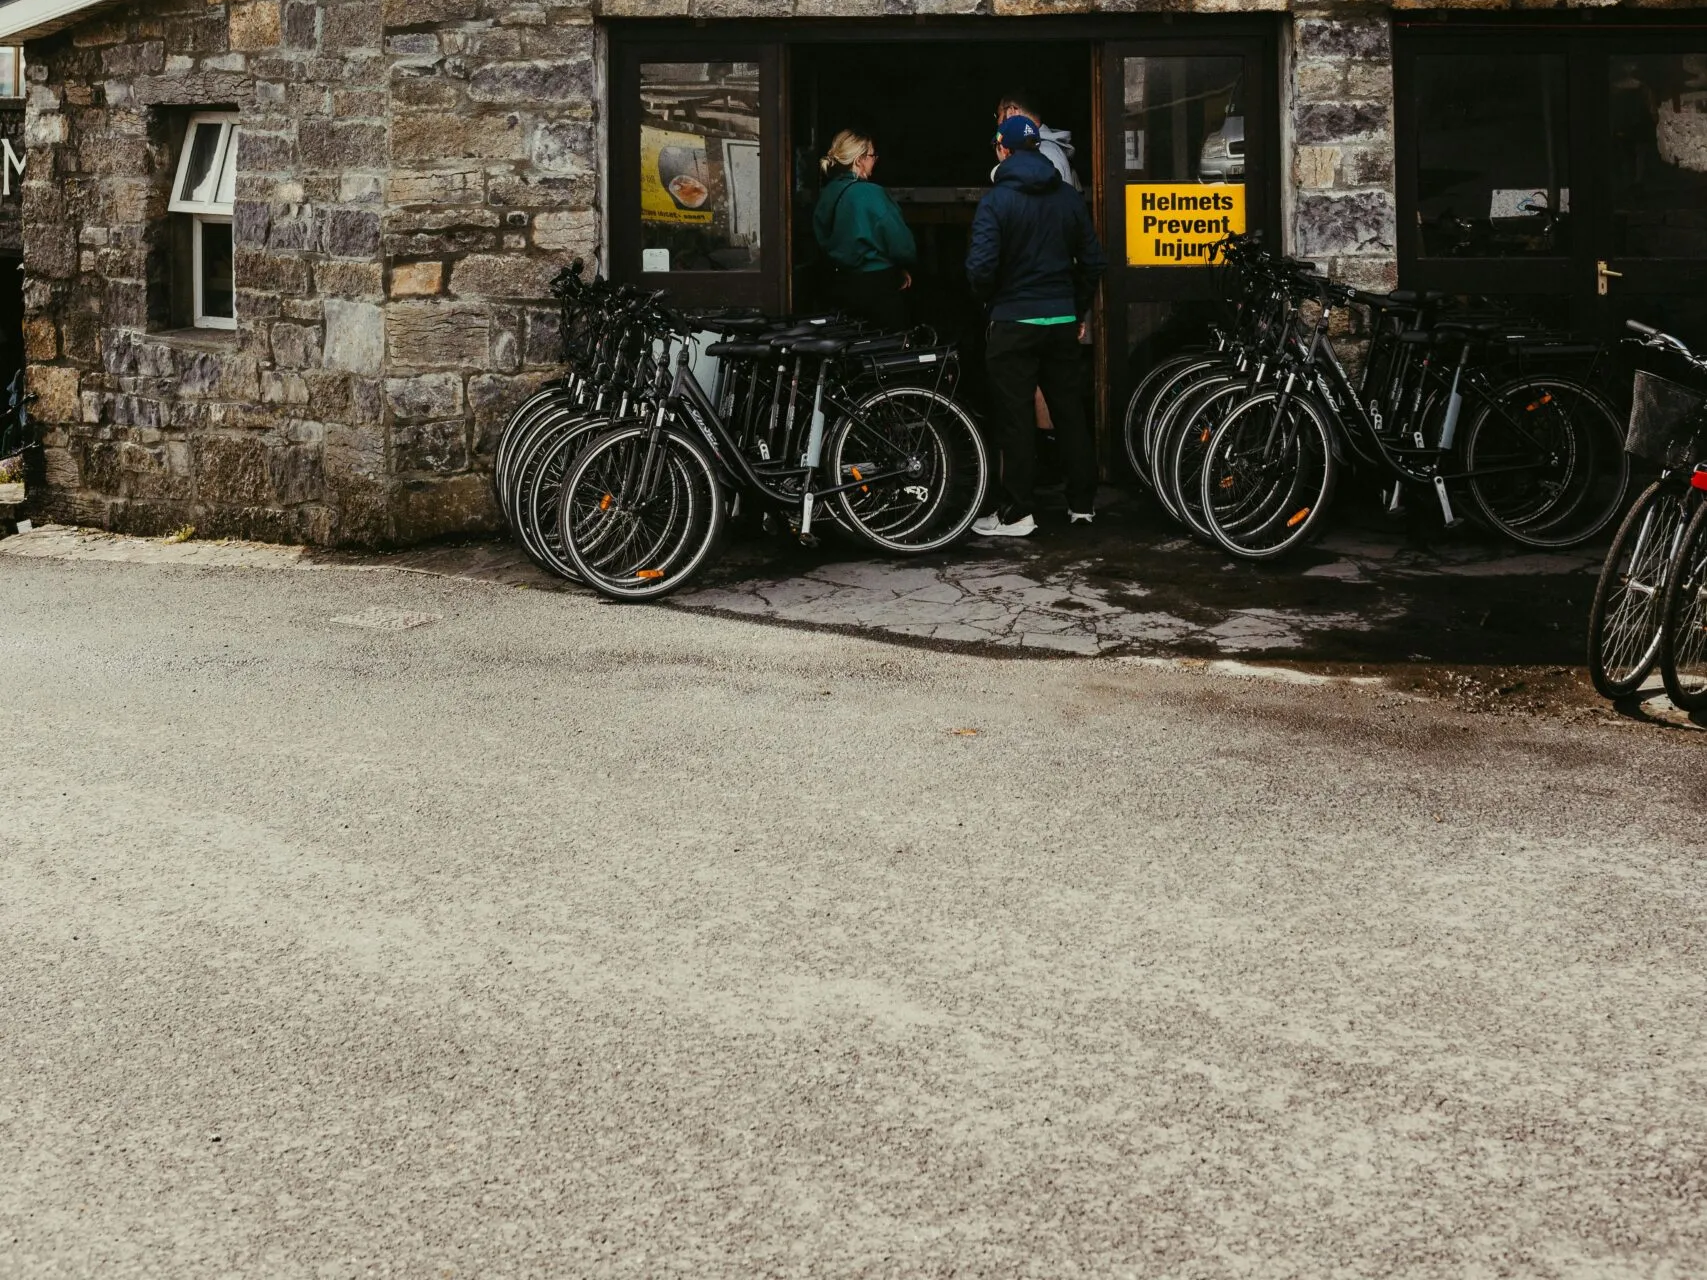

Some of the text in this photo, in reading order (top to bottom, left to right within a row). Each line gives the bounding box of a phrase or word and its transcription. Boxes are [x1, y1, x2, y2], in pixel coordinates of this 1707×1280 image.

[1141, 192, 1234, 211] Helmets
[1143, 215, 1231, 234] Prevent
[1154, 238, 1220, 262] Injury
